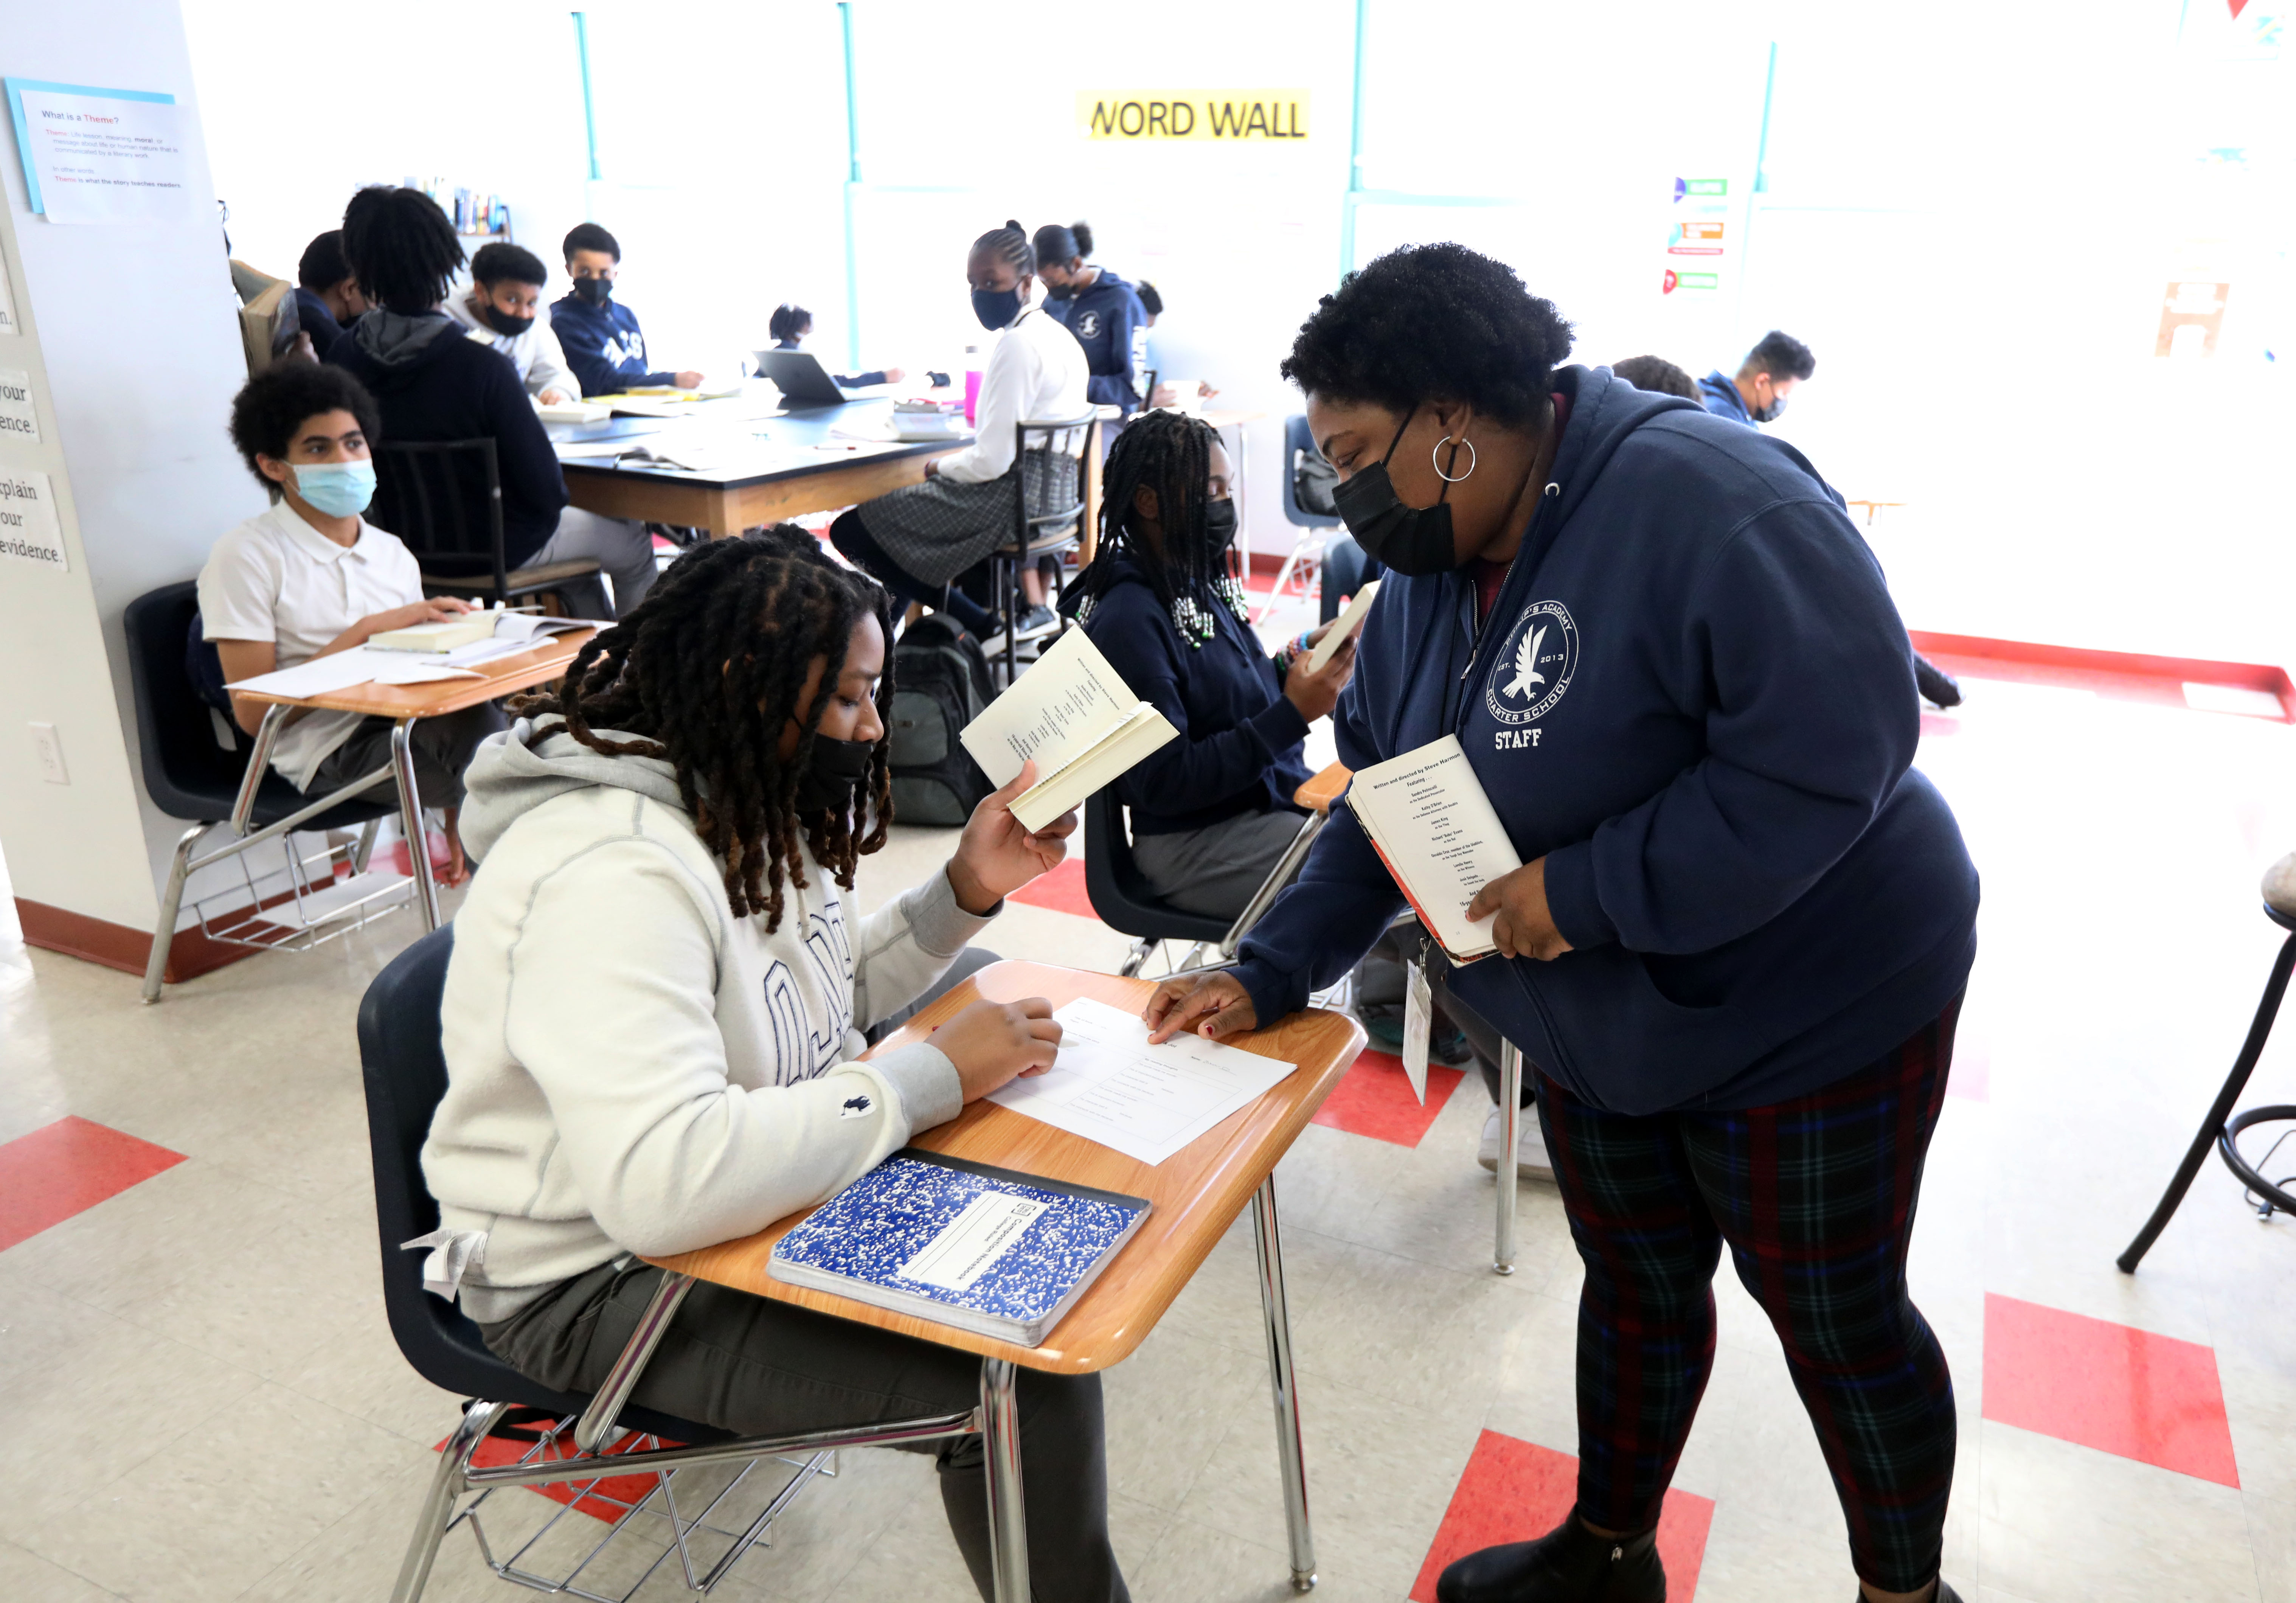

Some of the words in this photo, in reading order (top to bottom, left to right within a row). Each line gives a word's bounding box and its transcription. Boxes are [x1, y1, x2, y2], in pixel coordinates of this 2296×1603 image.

[42, 110, 65, 120] What
[84, 114, 119, 124] Theme?
[1209, 102, 1306, 138] WALL
[1542, 603, 1573, 630] ACADEMY
[1540, 654, 1564, 663] 2013
[1487, 688, 1519, 722] CHARTER
[1523, 676, 1570, 721] SCHOOL
[1495, 728, 1542, 750] STAFF
[1399, 770, 1417, 781] directed
[1424, 763, 1439, 771] Steve
[1439, 753, 1461, 764] Harmon
[1406, 778, 1425, 787] Featuring
[995, 1216, 1012, 1230] College
[984, 1230, 998, 1242] Ruled
[986, 1219, 1022, 1252] Composition
[956, 1253, 989, 1280] Notebook
